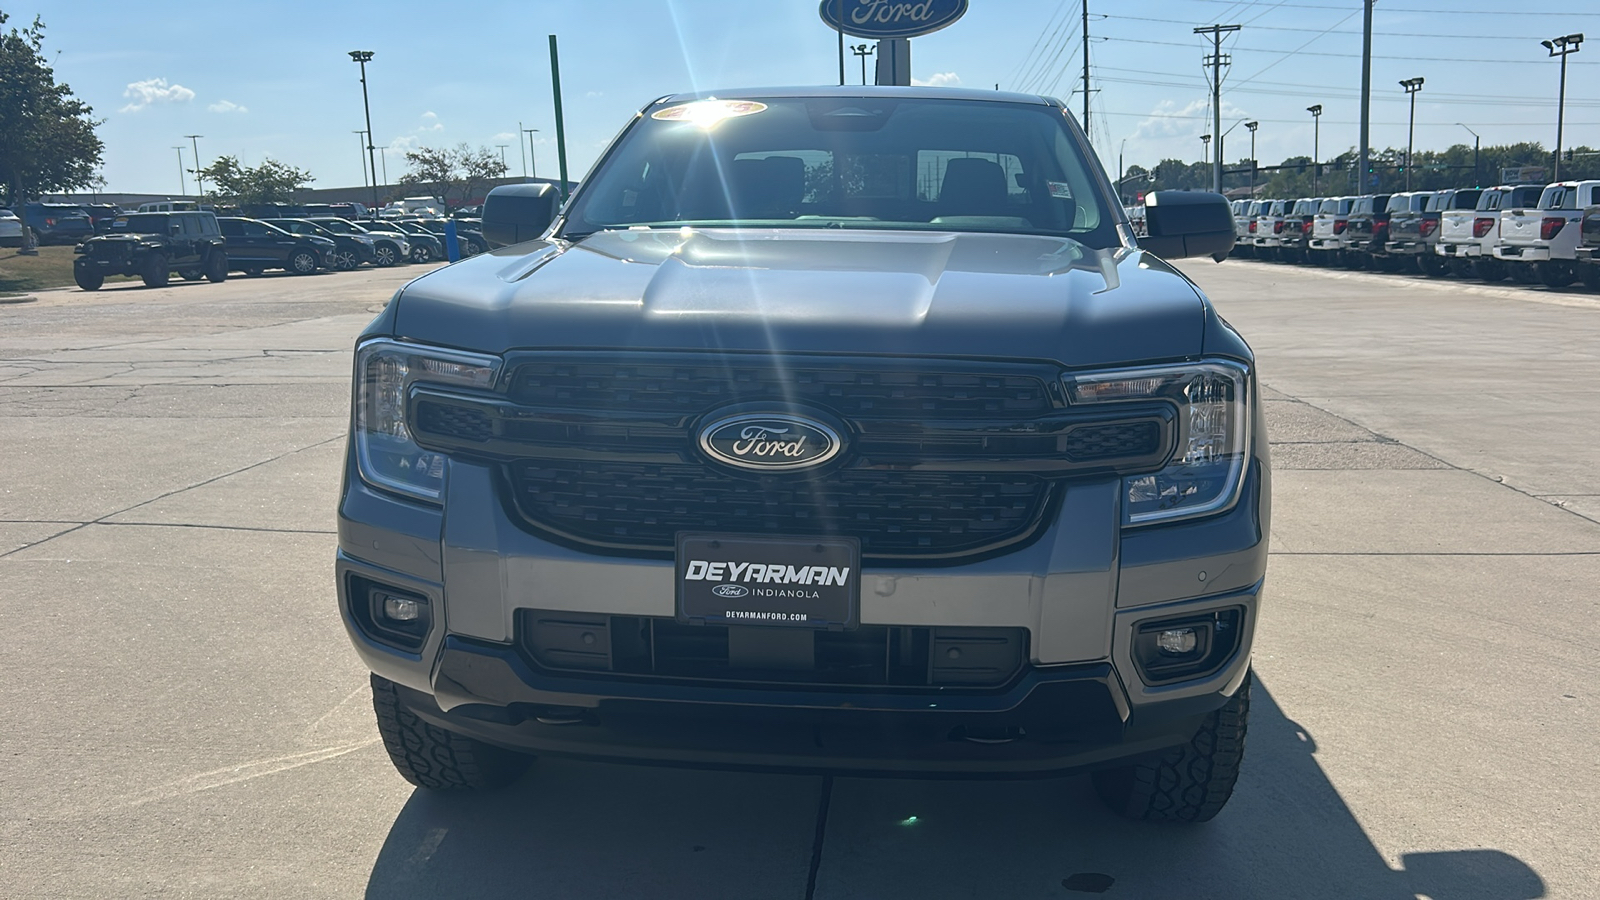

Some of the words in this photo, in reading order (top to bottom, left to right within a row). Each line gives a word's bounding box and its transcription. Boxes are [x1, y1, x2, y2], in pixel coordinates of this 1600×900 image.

[851, 0, 934, 24] Ford
[732, 425, 807, 457] Ford
[685, 560, 850, 586] DEYARMAN
[752, 588, 820, 599] INDIANOLA
[726, 610, 807, 621] DEYARMANFORD.COM
